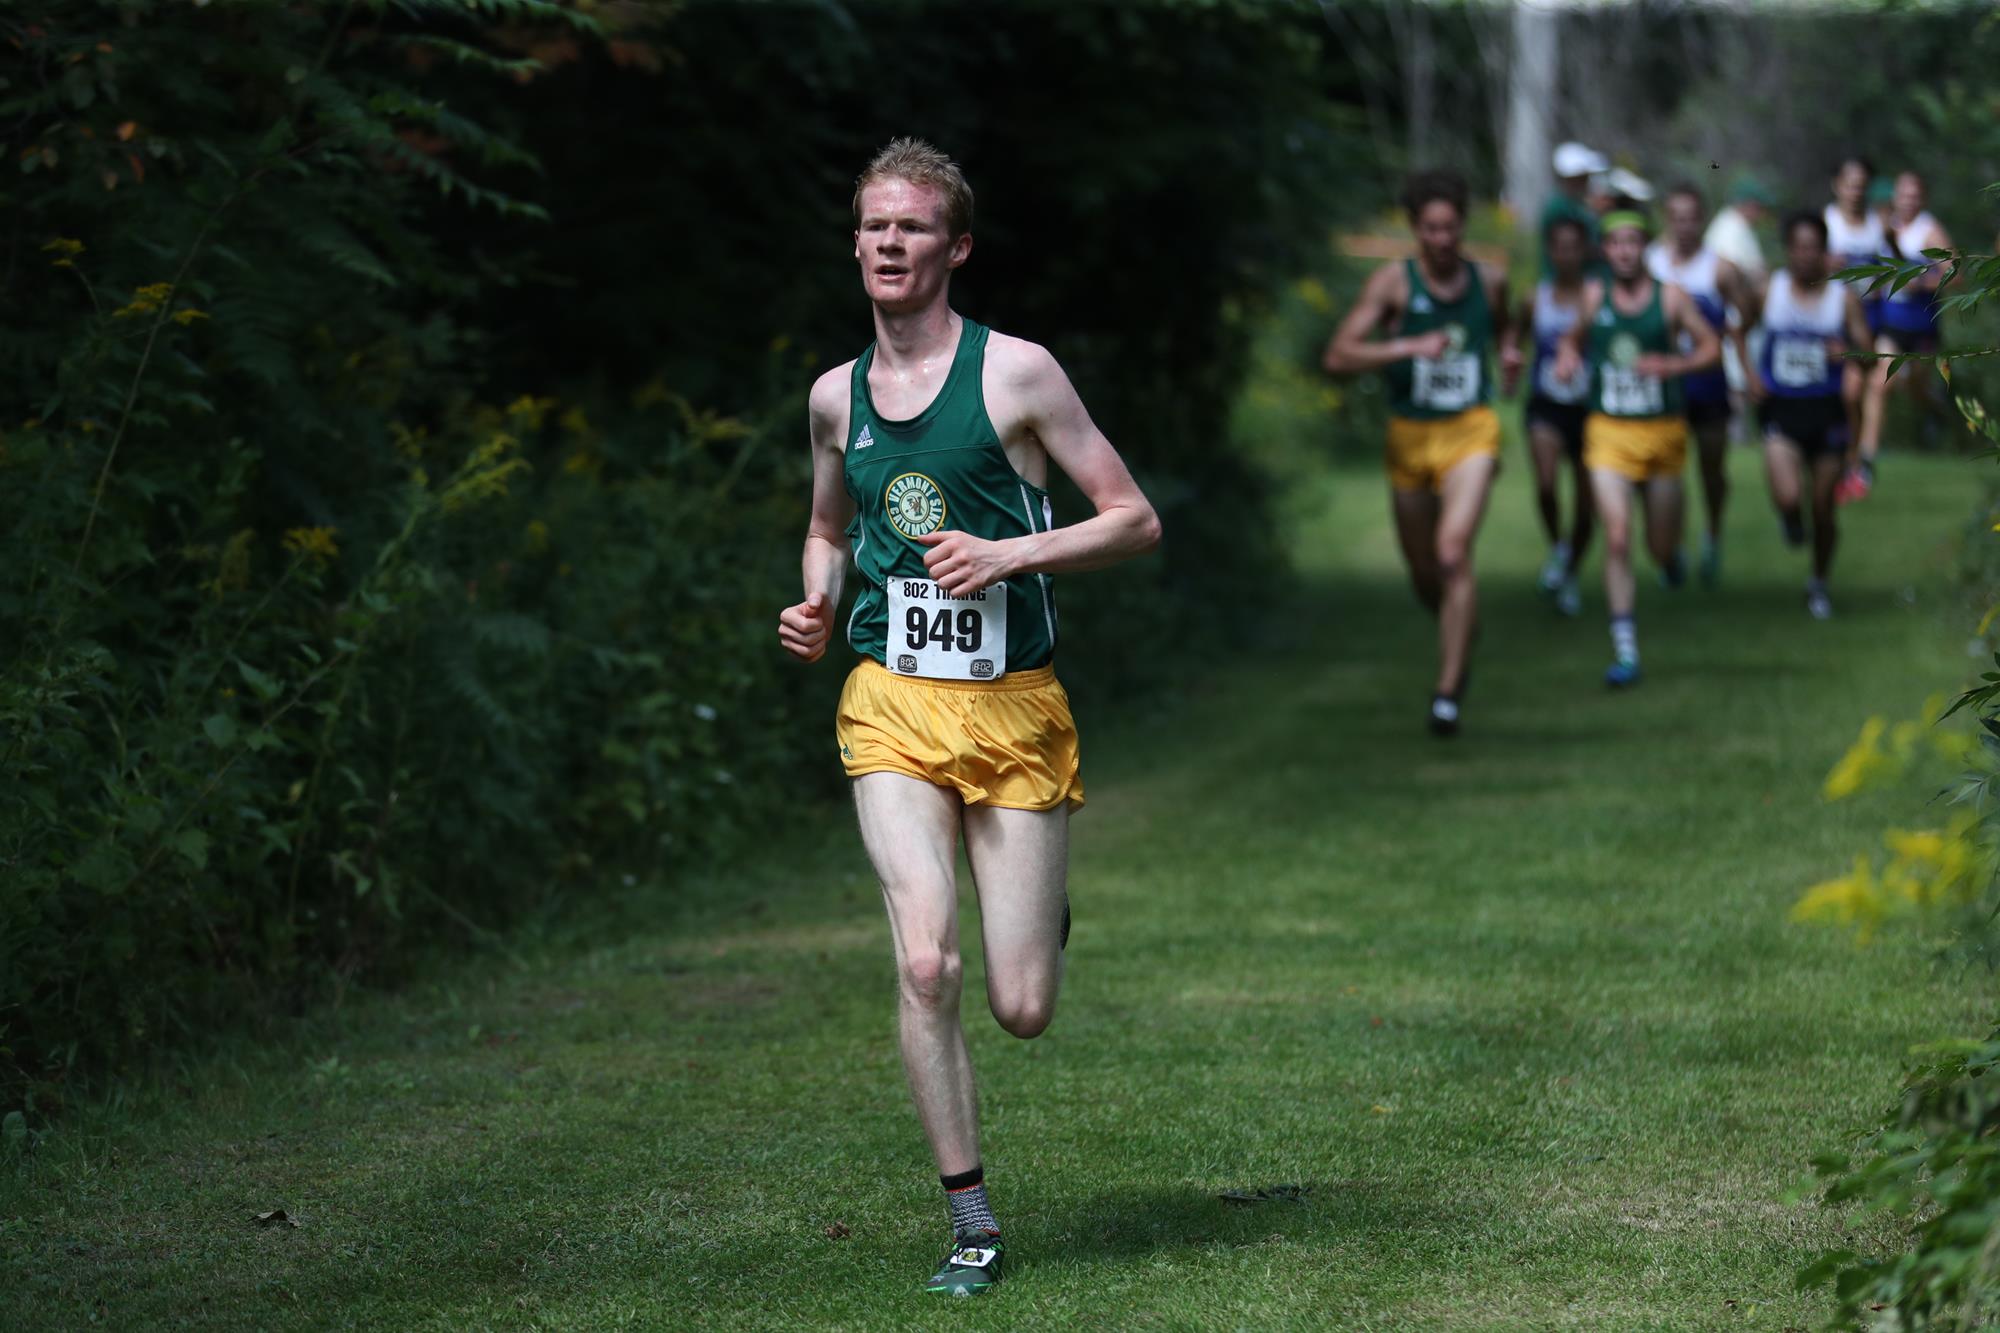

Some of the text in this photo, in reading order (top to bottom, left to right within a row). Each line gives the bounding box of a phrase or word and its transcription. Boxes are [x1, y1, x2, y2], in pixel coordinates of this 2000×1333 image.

[854, 438, 874, 450] adidas
[888, 476, 937, 502] VERMONT
[890, 498, 942, 536] CATAMOUNTS
[903, 581, 987, 601] 802 TING
[905, 606, 983, 653] 949
